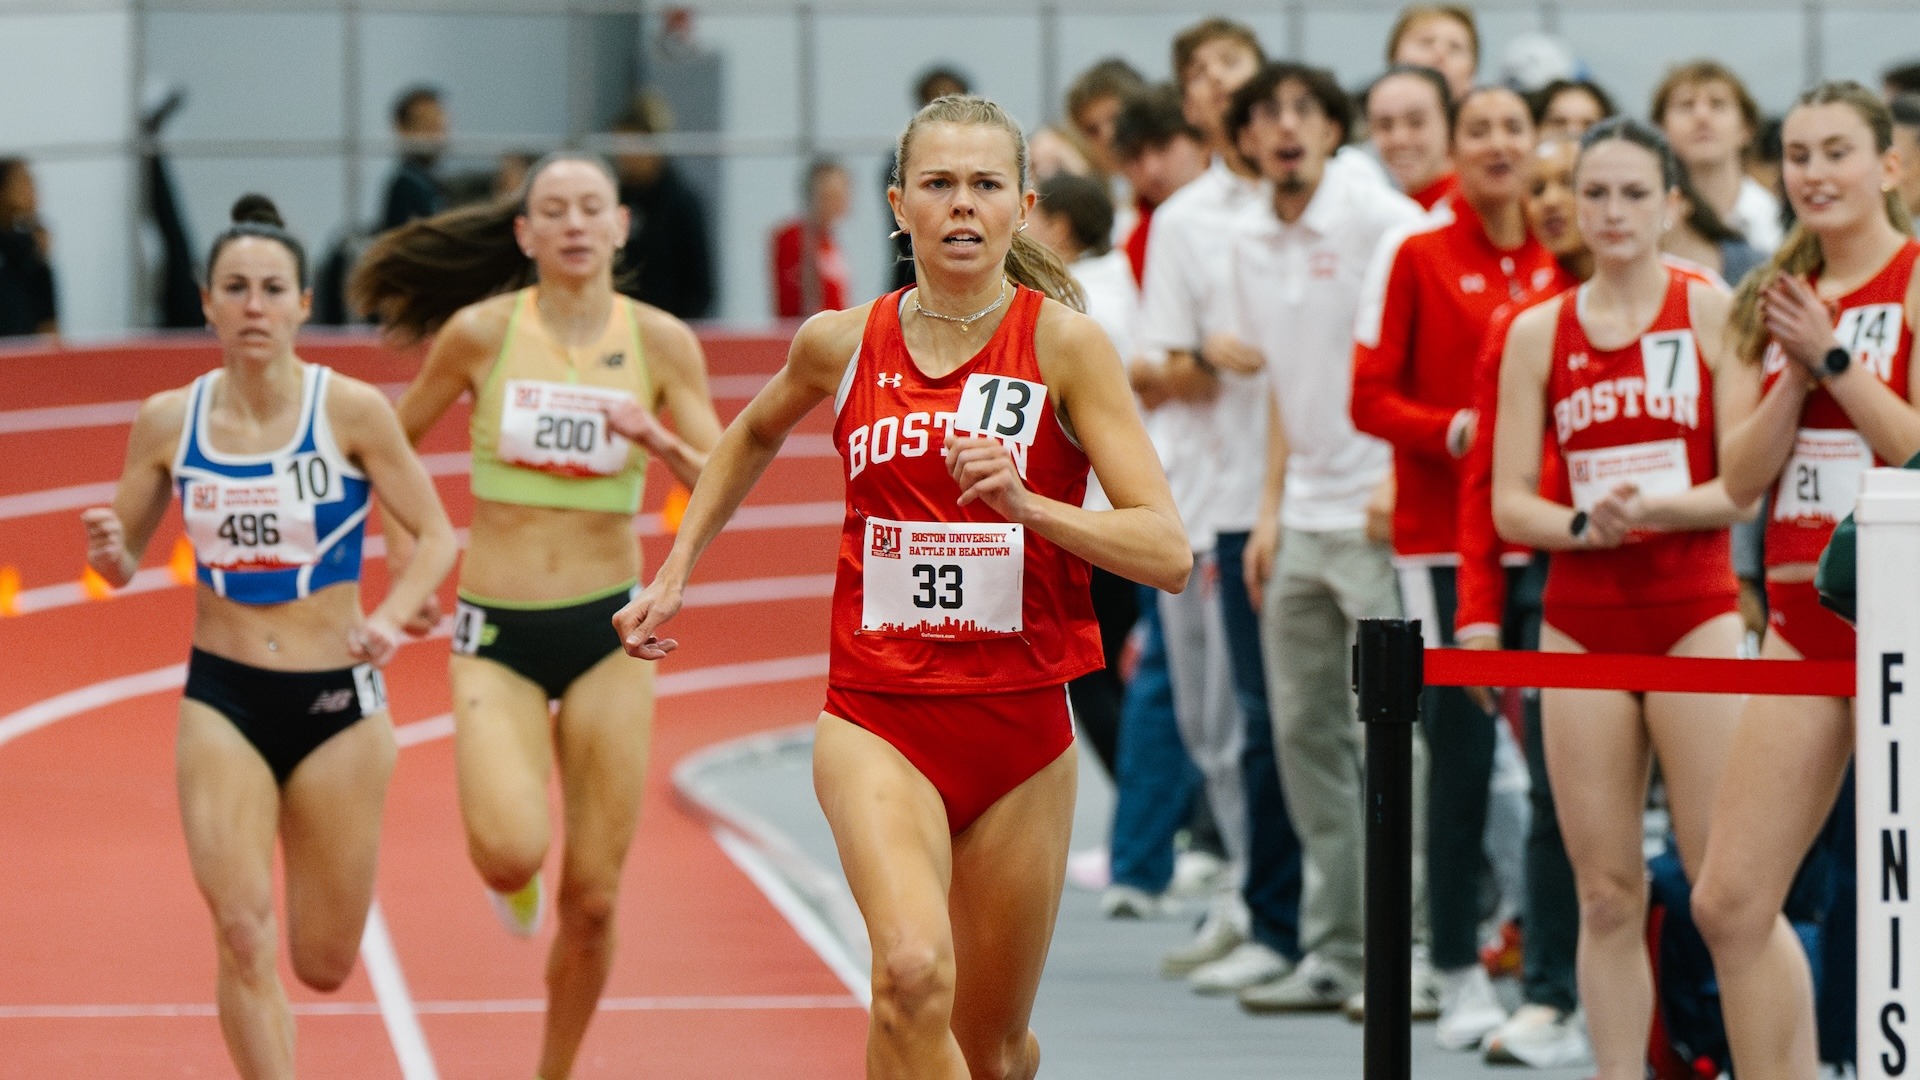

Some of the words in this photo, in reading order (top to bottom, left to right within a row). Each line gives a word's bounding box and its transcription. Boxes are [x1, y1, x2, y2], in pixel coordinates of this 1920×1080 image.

[1854, 310, 1887, 349] 14
[1656, 338, 1682, 391] 7
[978, 378, 1031, 436] 13
[535, 415, 596, 453] 200
[287, 457, 330, 500] 10
[1797, 464, 1821, 503] 21
[217, 512, 281, 547] 496
[872, 523, 902, 553] BU
[911, 532, 946, 543] BOSTON
[949, 533, 1007, 543] UNIVERSITY
[909, 546, 944, 557] BATTLE
[946, 547, 956, 557] IN
[959, 547, 1010, 557] BEANTOWN
[912, 564, 963, 609] 33
[1880, 652, 1909, 1078] FINIS
